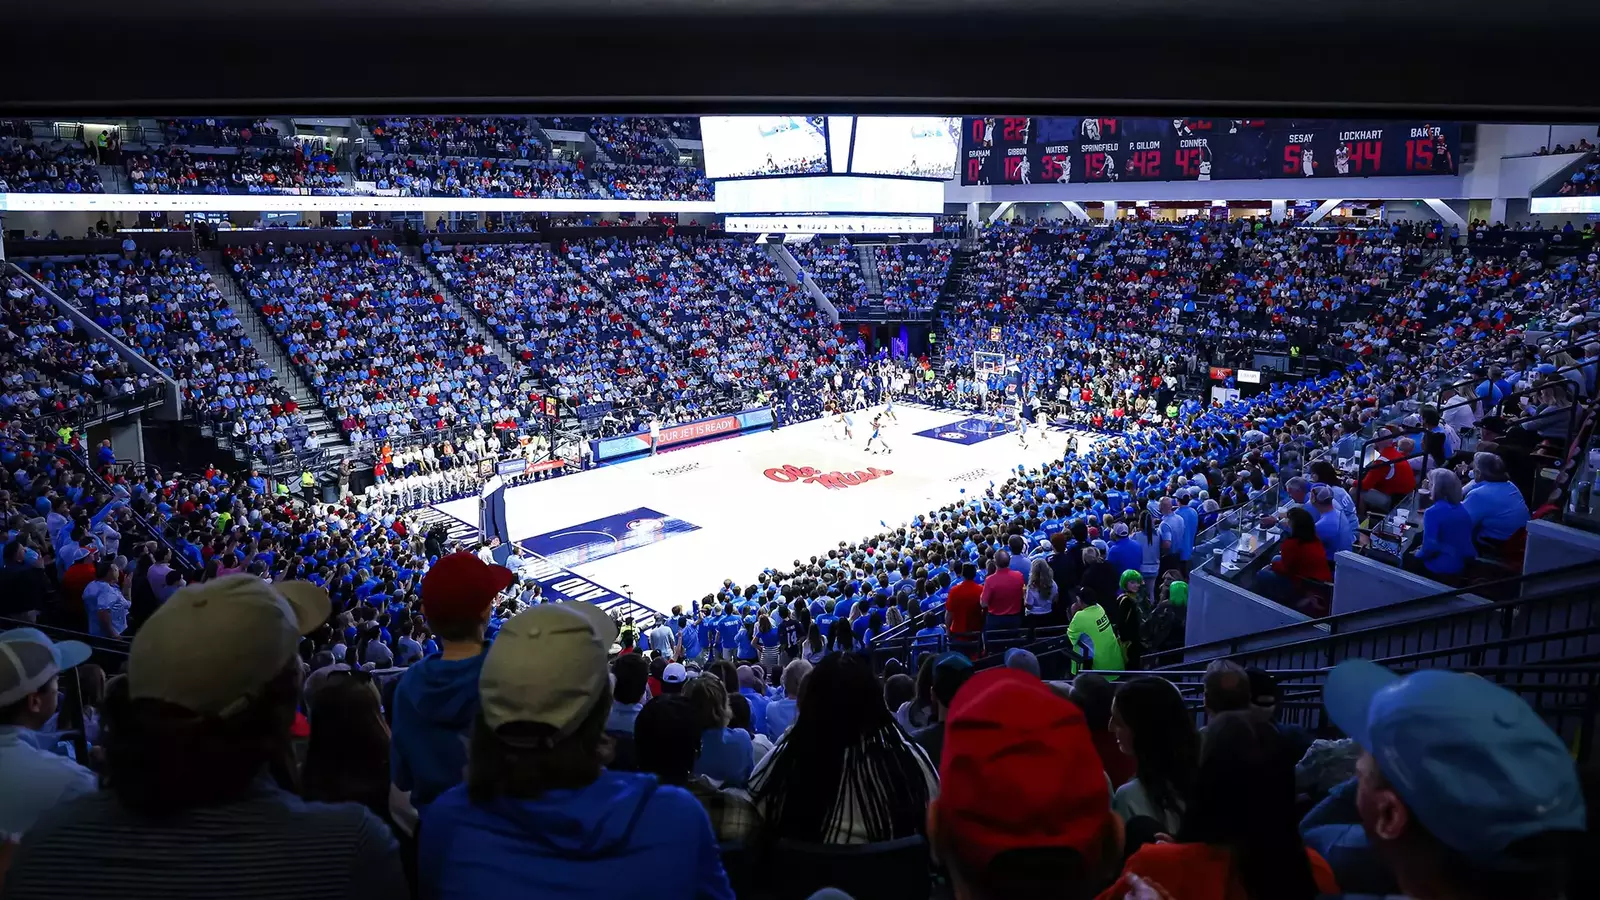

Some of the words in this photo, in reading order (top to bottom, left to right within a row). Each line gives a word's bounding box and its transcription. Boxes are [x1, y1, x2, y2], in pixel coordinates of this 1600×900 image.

[1339, 129, 1383, 141] LOCKHART
[1410, 126, 1441, 138] BAKER
[1180, 138, 1208, 148] CONNER
[1289, 133, 1314, 143] SESAY
[1045, 145, 1069, 154] WATERS
[1081, 143, 1119, 152] SPRINGFIELD
[1129, 142, 1135, 150] P.
[1136, 140, 1160, 150] GILLOM
[968, 149, 991, 157] GRAHAM
[1007, 148, 1027, 156] GIBBON
[1346, 141, 1383, 173] 44
[1405, 139, 1433, 171] 15
[1133, 151, 1161, 176] 42
[658, 431, 679, 443] OUR
[680, 427, 695, 439] JET
[696, 425, 704, 435] IS
[705, 420, 733, 433] READY
[763, 464, 821, 483] Ole
[802, 466, 894, 490] Miss
